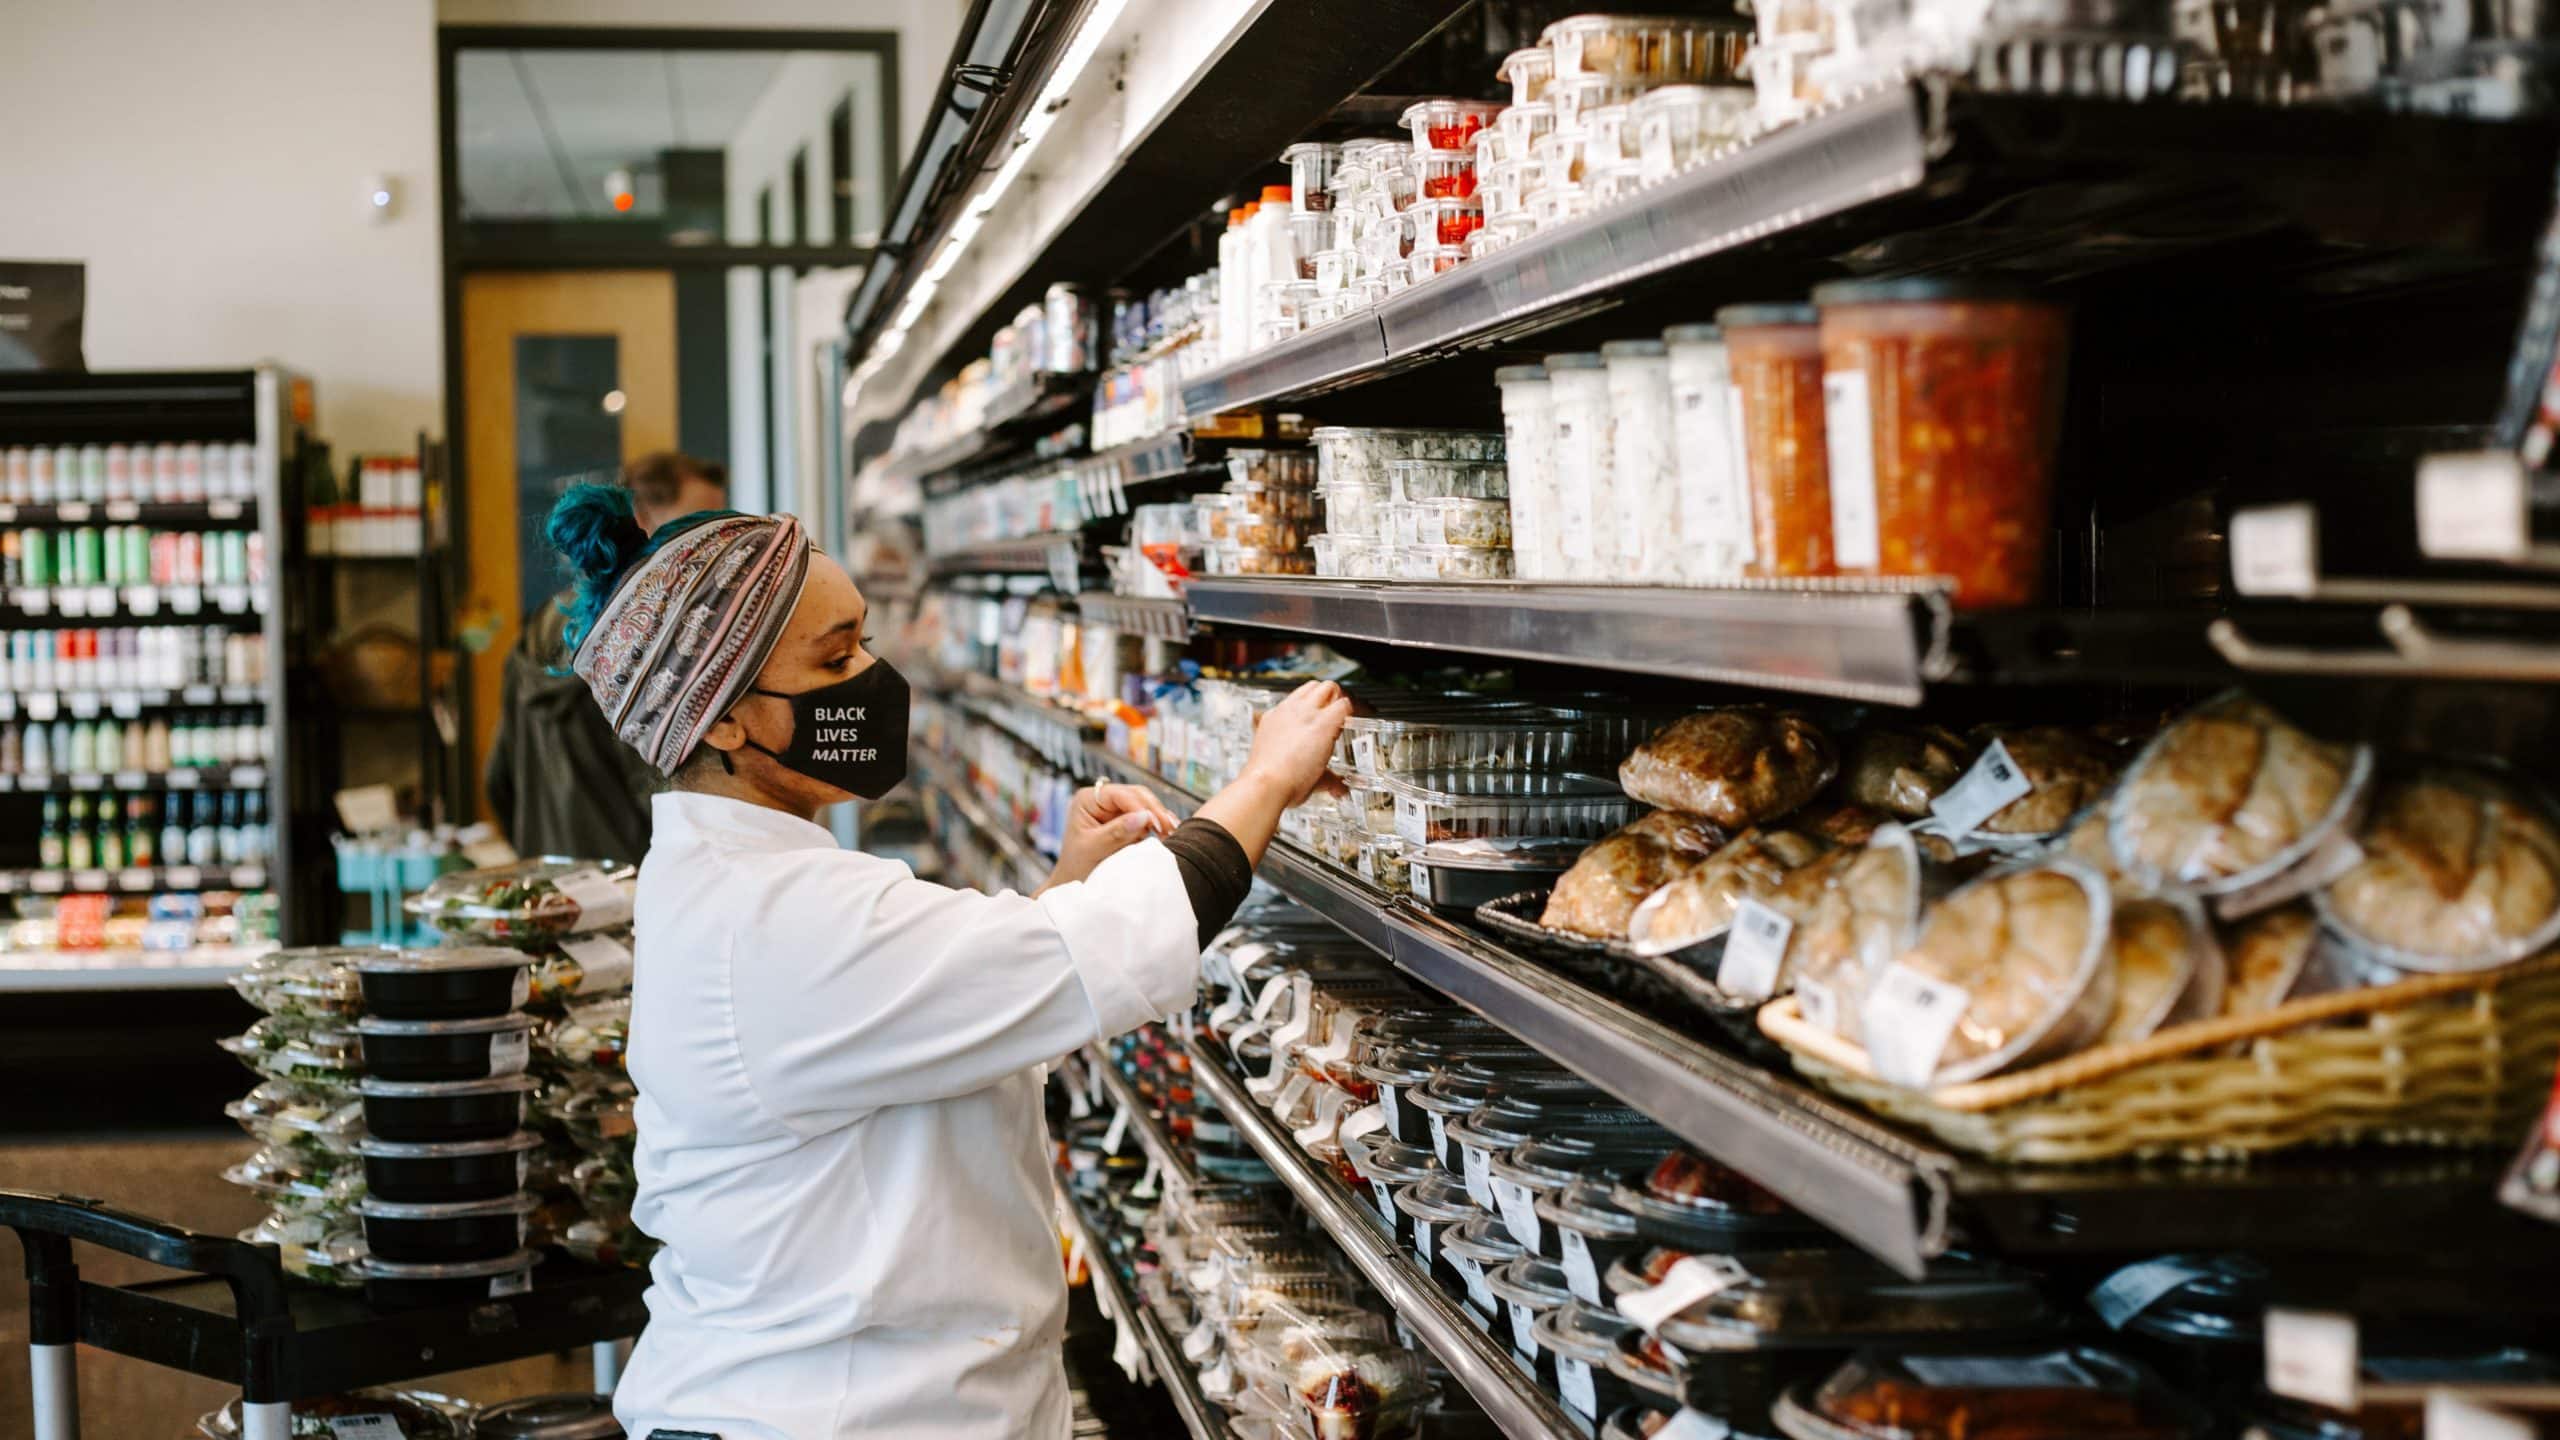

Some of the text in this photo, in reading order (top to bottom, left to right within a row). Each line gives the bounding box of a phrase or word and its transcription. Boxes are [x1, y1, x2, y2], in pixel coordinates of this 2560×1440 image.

[815, 707, 866, 721] BLACK
[816, 728, 858, 742] LIVES
[812, 748, 877, 762] MATTER
